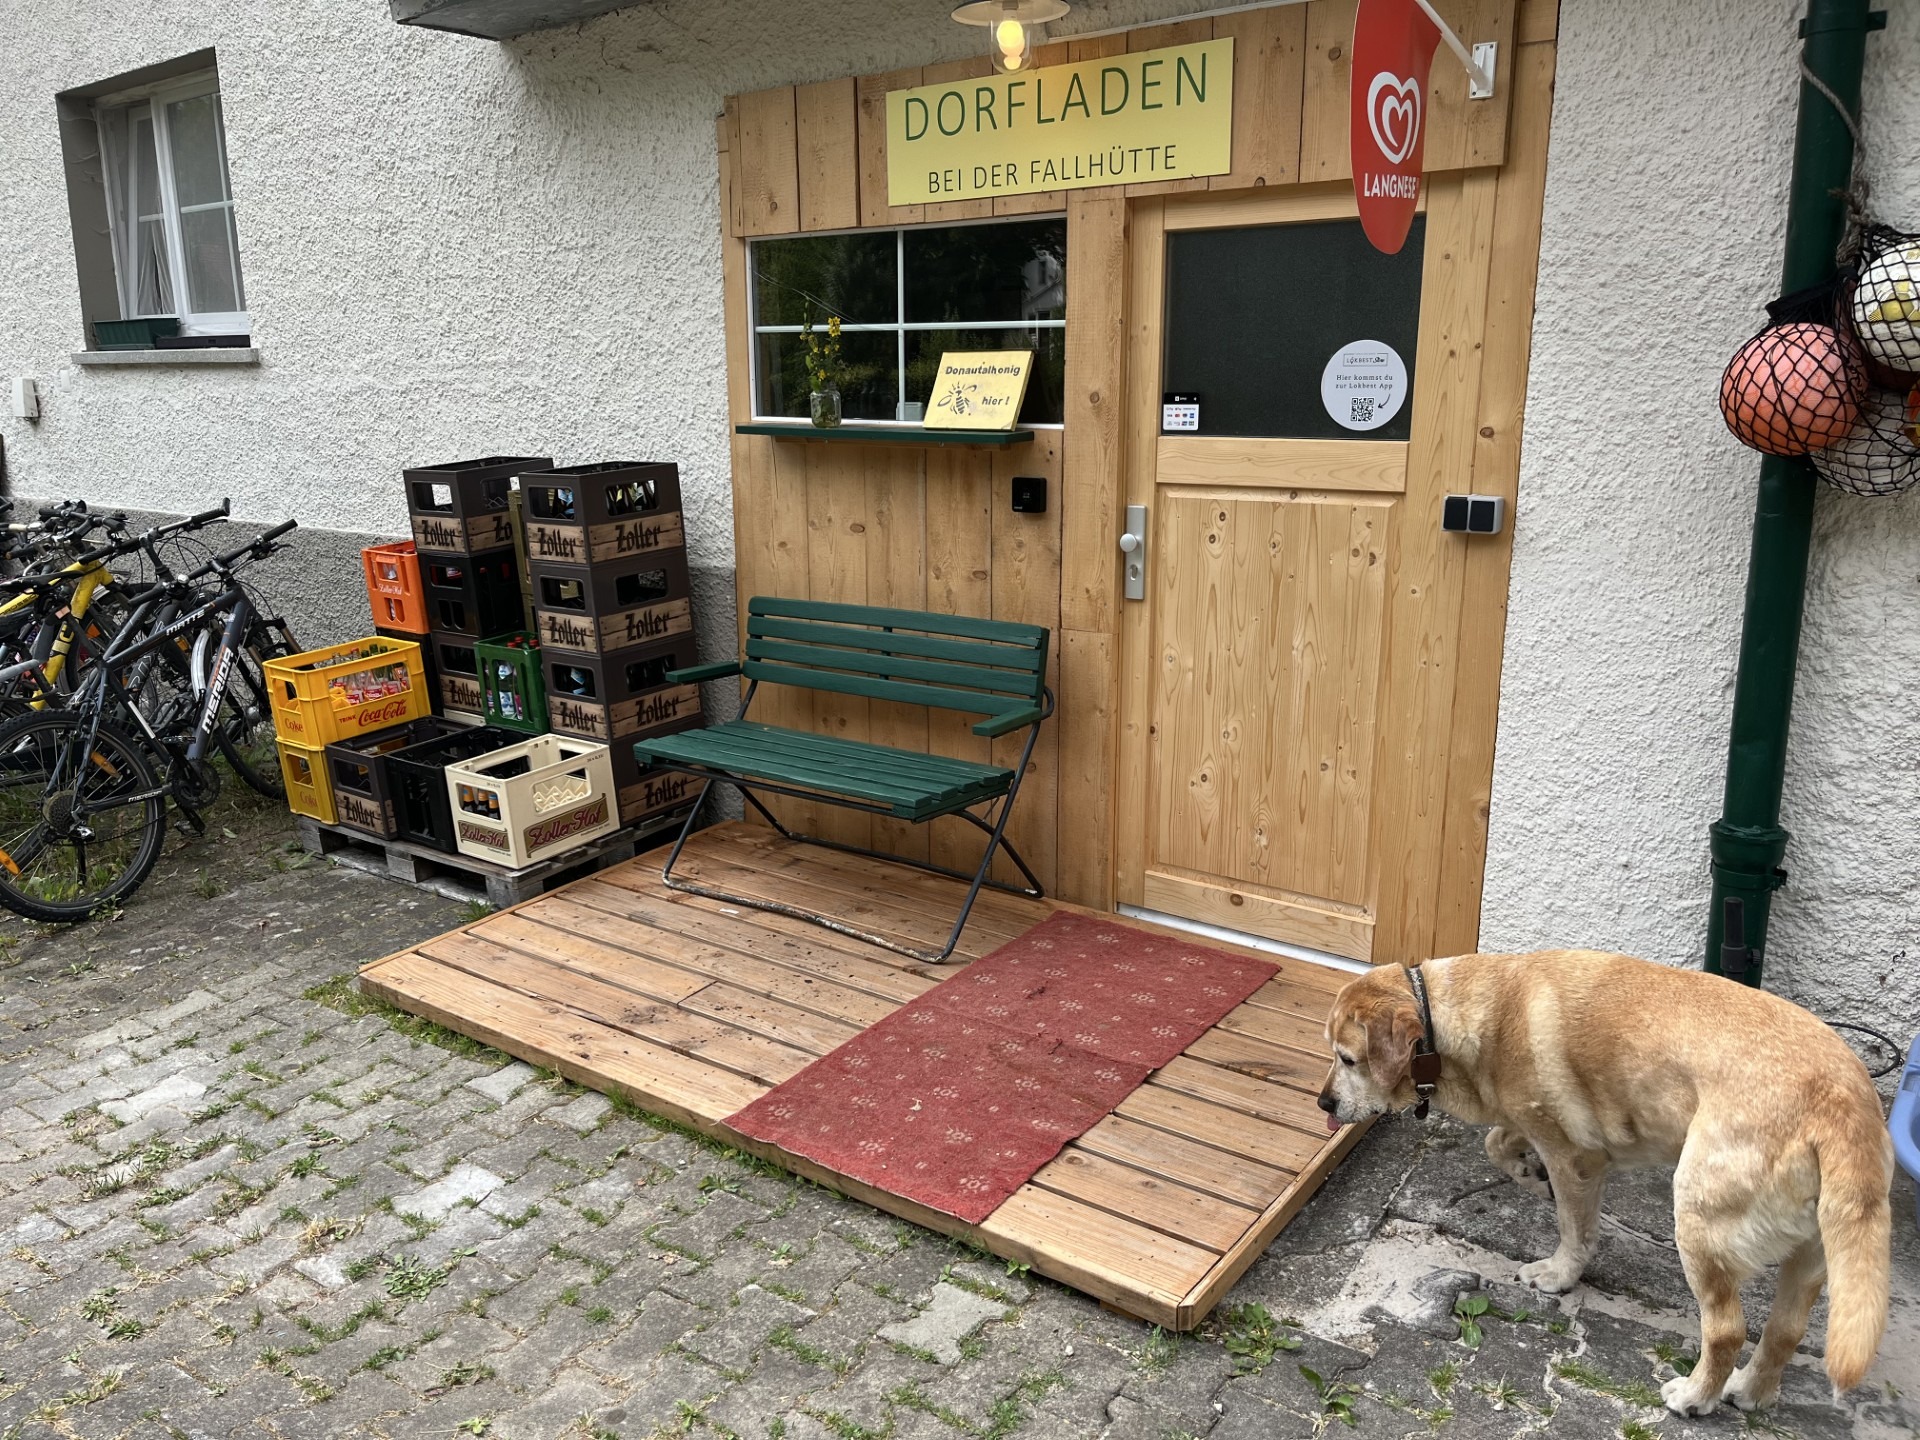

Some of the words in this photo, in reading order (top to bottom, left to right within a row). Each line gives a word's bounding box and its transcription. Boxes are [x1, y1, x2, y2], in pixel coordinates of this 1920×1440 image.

[905, 52, 1206, 141] DORFLADEN
[928, 168, 962, 194] BEI
[974, 162, 1018, 189] DER
[1030, 145, 1176, 184] FALLHÜTTE
[1364, 172, 1416, 199] LANGNESE
[945, 365, 1020, 377] Donautalhonig
[981, 396, 1004, 406] hier
[1379, 383, 1393, 391] App
[421, 519, 455, 547] Zoller
[537, 527, 576, 558] Zoller
[614, 521, 660, 553] Zoller
[548, 616, 586, 647] Zoller
[625, 609, 669, 642] Zoller
[201, 646, 234, 734] MERIDA
[284, 717, 304, 733] Coke
[339, 714, 357, 723] TRINK
[358, 698, 407, 727] Coca-Cola
[560, 701, 597, 733] Zoller
[635, 695, 679, 727] Zoller
[644, 776, 688, 809] Zoller
[342, 795, 376, 828] Zoller
[528, 805, 603, 849] Zoller-Hof
[460, 823, 506, 849] Zoller-Hof
